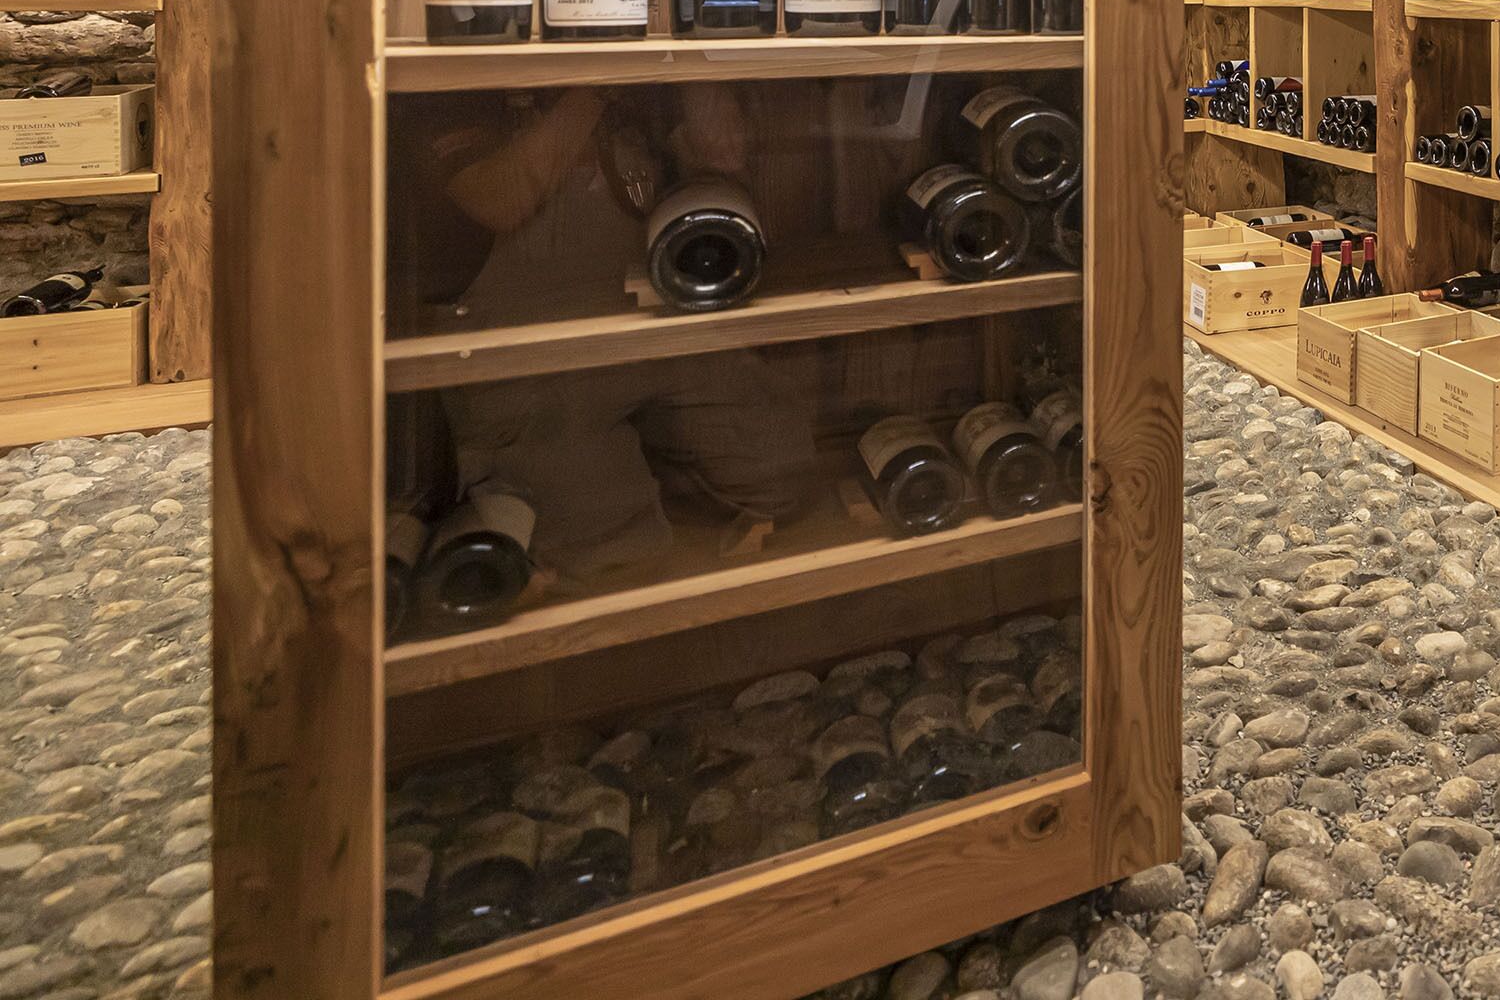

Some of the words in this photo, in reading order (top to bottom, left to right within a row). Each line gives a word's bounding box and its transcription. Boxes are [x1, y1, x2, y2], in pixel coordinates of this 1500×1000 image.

[12, 121, 56, 131] PREMIUM
[58, 120, 82, 129] WINE
[1246, 307, 1286, 317] COPPO
[1304, 338, 1342, 369] LUPICAIA
